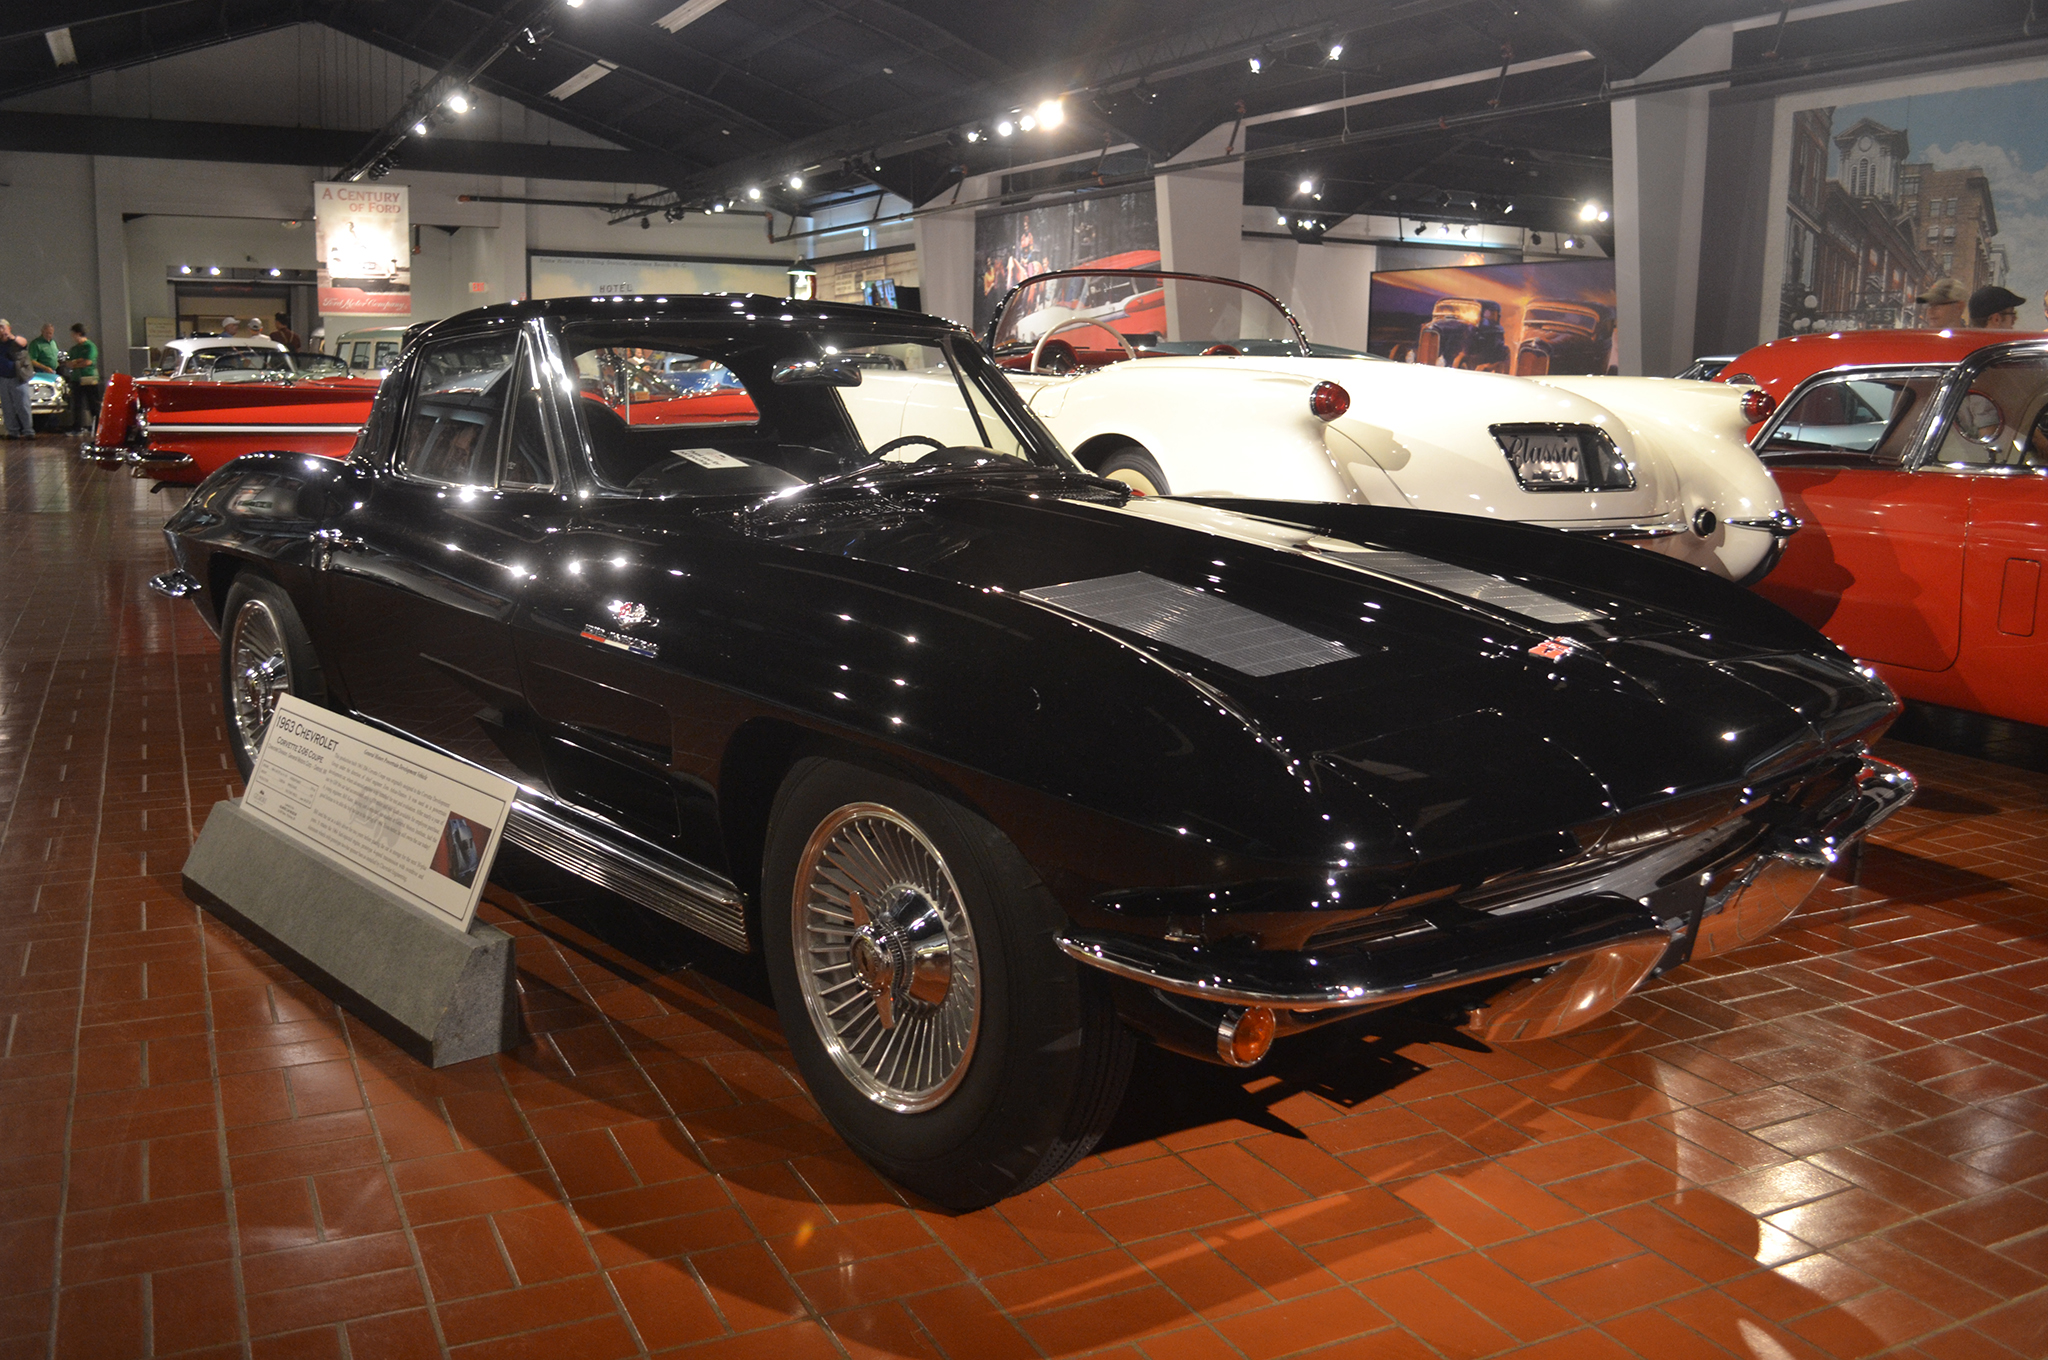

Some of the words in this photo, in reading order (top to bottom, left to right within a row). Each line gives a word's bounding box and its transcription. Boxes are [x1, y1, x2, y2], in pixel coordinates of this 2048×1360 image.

[322, 188, 333, 200] A
[337, 188, 401, 203] CENTURY
[349, 202, 364, 213] OF
[368, 202, 401, 214] FORD
[599, 284, 633, 293] HOTEL
[322, 297, 343, 307] Ford
[340, 298, 367, 309] Motor
[1507, 436, 1581, 469] Classic
[276, 715, 296, 733] 1963
[295, 723, 339, 752] CHEVROLET
[277, 736, 298, 752] CORVETTE
[308, 750, 325, 763] COUPE
